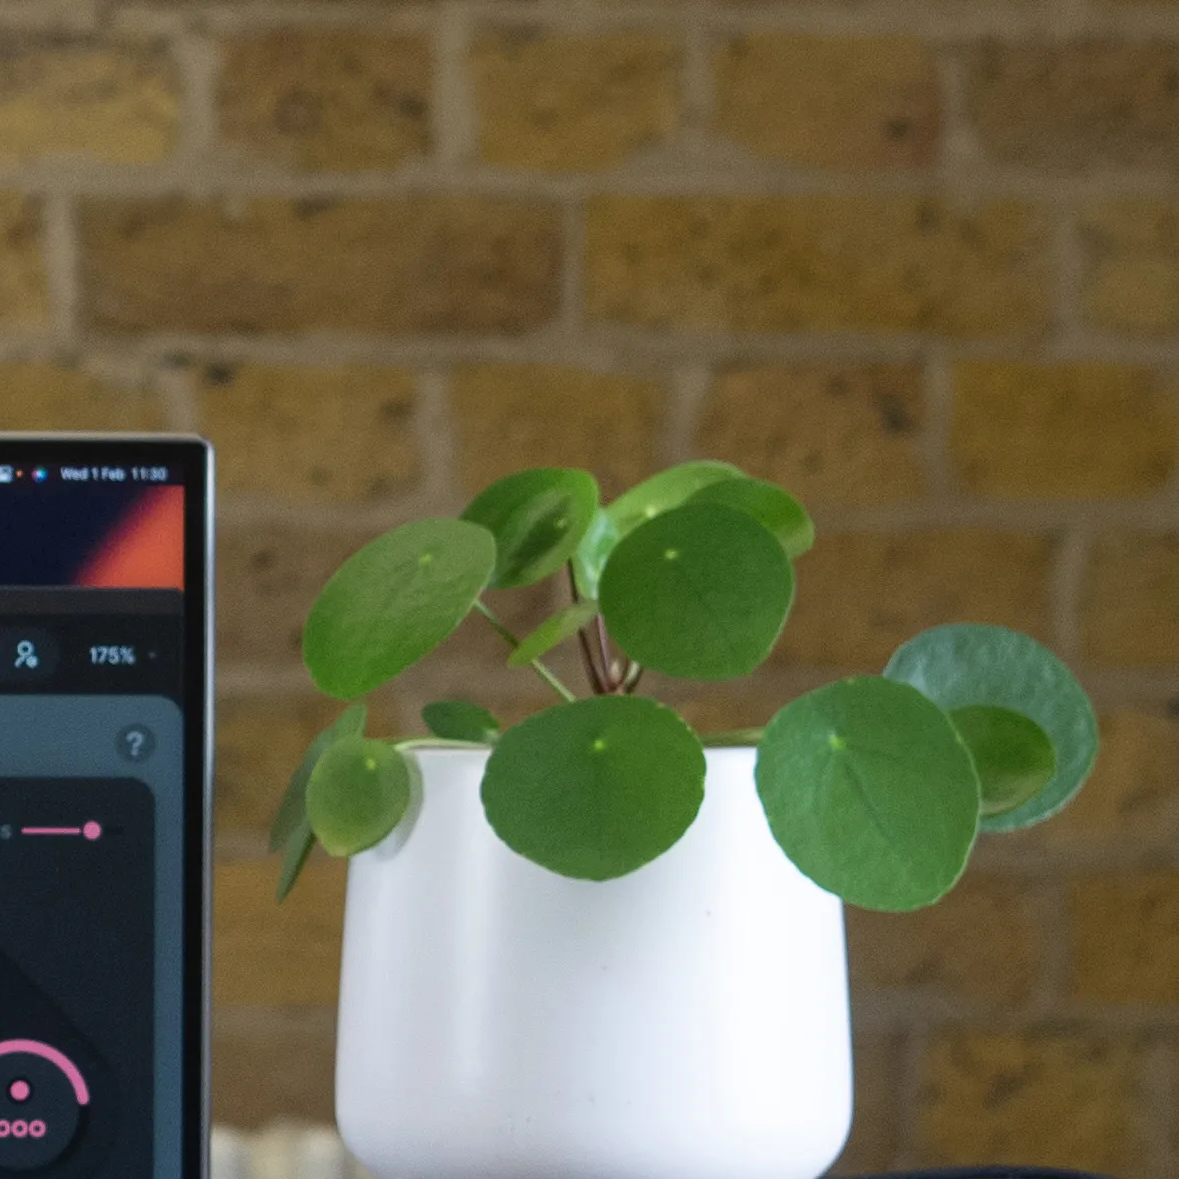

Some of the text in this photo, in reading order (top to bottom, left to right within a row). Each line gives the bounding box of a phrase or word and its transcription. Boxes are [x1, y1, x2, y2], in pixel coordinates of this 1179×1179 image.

[61, 467, 88, 480] Wed
[101, 467, 125, 480] Feb
[90, 646, 135, 664] 175%
